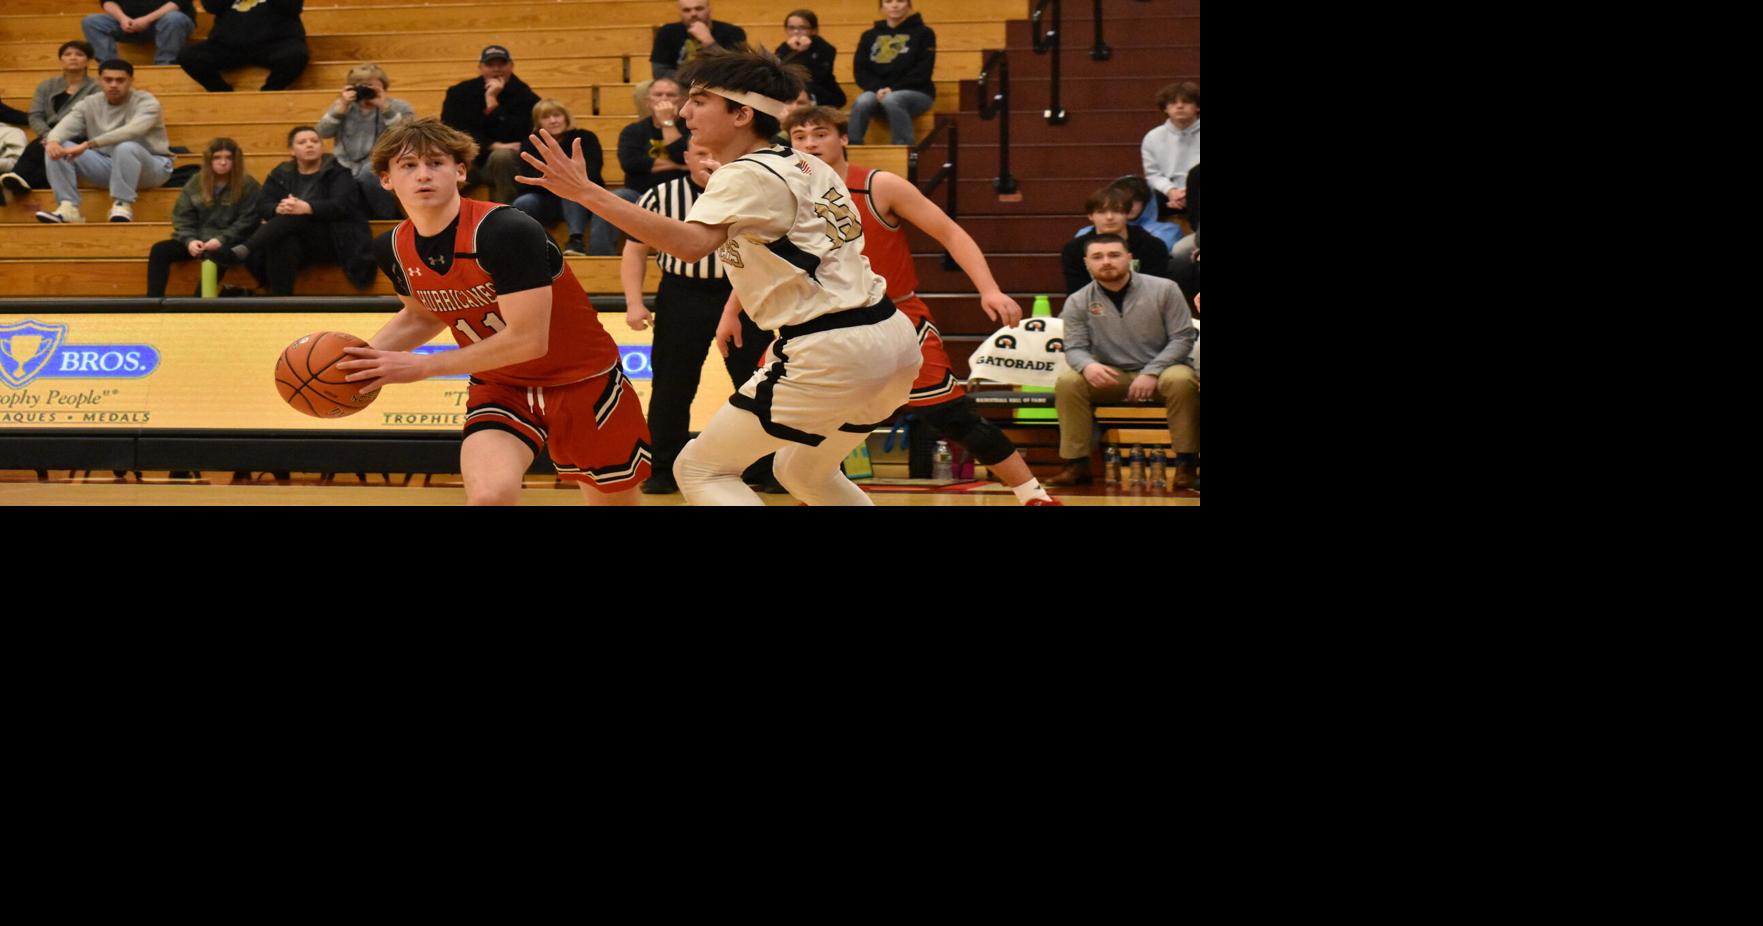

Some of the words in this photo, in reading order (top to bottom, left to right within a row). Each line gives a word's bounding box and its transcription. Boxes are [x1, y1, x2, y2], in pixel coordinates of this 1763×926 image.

[815, 187, 863, 251] 15
[416, 282, 498, 312] HURRICANES
[59, 351, 147, 371] BROS.
[976, 356, 1056, 372] GATORADE
[83, 412, 150, 422] MEDALS
[384, 414, 465, 424] TROPHIE
